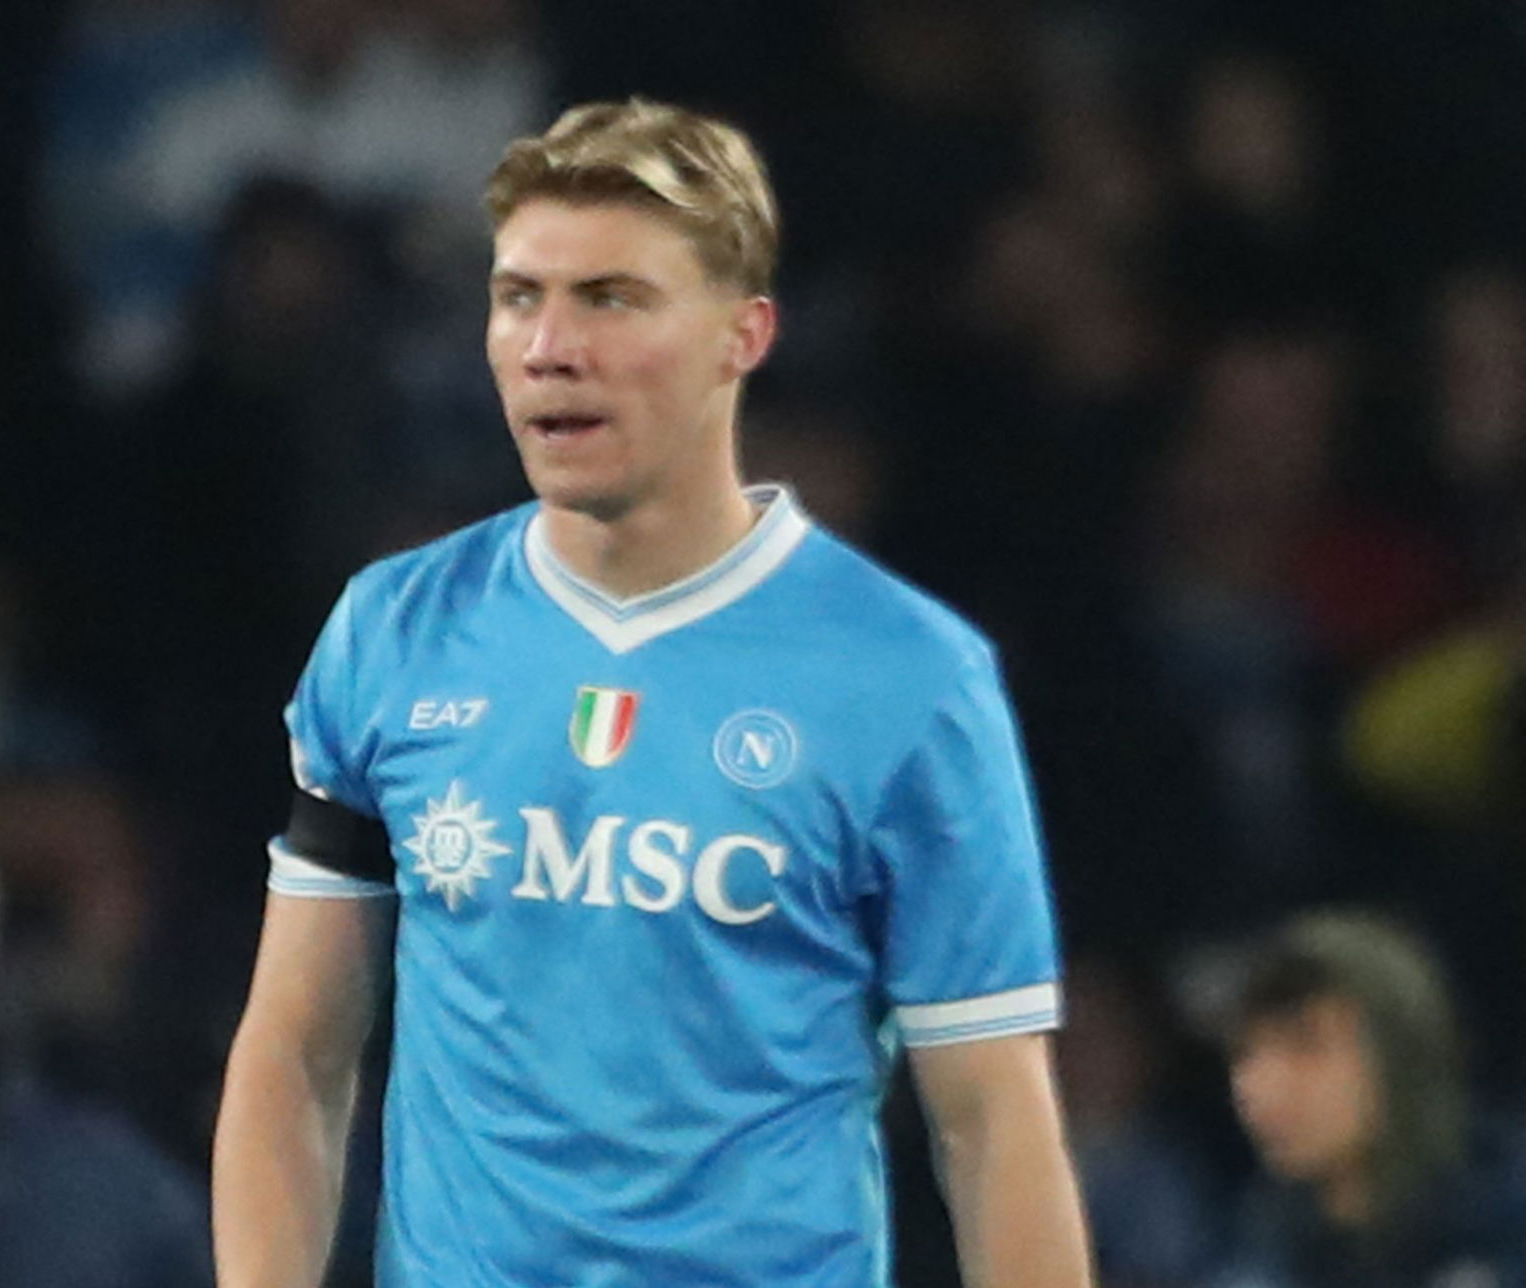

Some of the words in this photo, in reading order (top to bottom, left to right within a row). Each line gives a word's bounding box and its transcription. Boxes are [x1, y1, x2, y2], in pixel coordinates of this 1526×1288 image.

[408, 700, 488, 729] EA7
[737, 731, 772, 768] N
[511, 807, 785, 925] MSC
